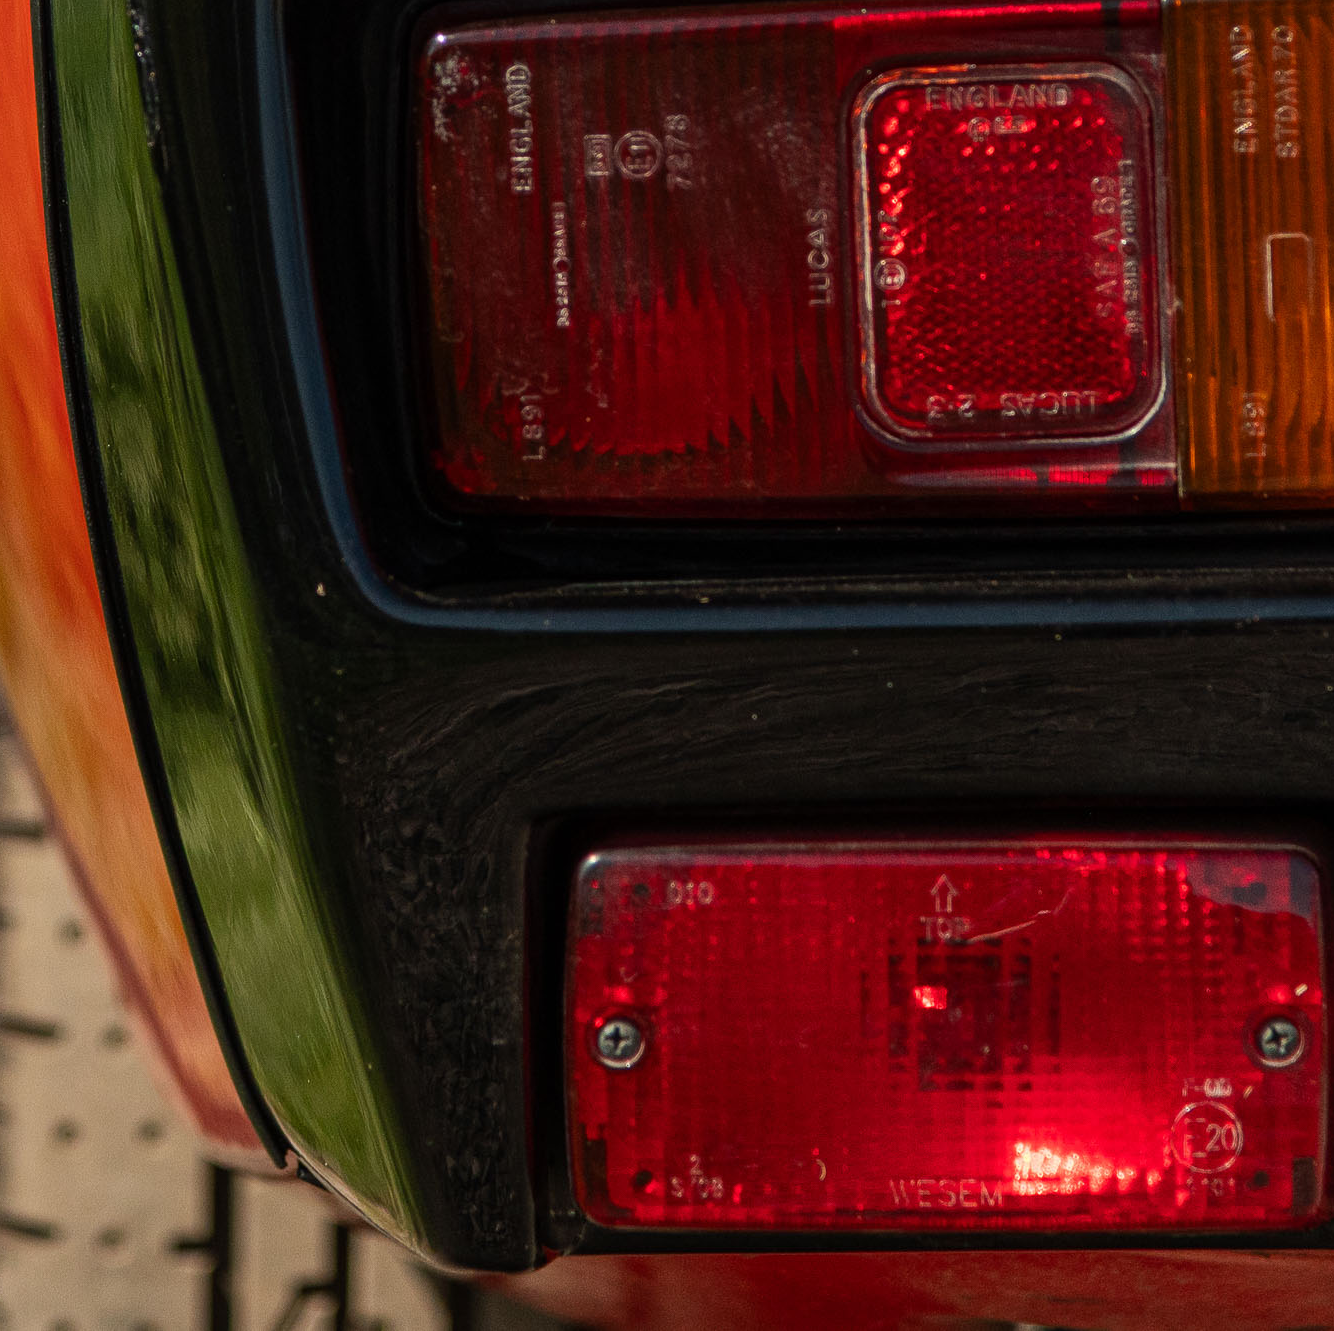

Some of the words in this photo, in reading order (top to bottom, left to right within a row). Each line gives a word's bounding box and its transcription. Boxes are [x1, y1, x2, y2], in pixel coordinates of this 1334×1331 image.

[924, 84, 1070, 111] ENGLAND
[1229, 24, 1258, 154] ENGLAND
[505, 62, 533, 194] ENGLAND
[664, 114, 693, 191] 7278
[805, 207, 833, 308] LUCAS
[1000, 390, 1100, 418] LUCAS
[919, 915, 972, 943] TOP
[1183, 1117, 1238, 1158] E20
[888, 1178, 1003, 1208] WESEM
